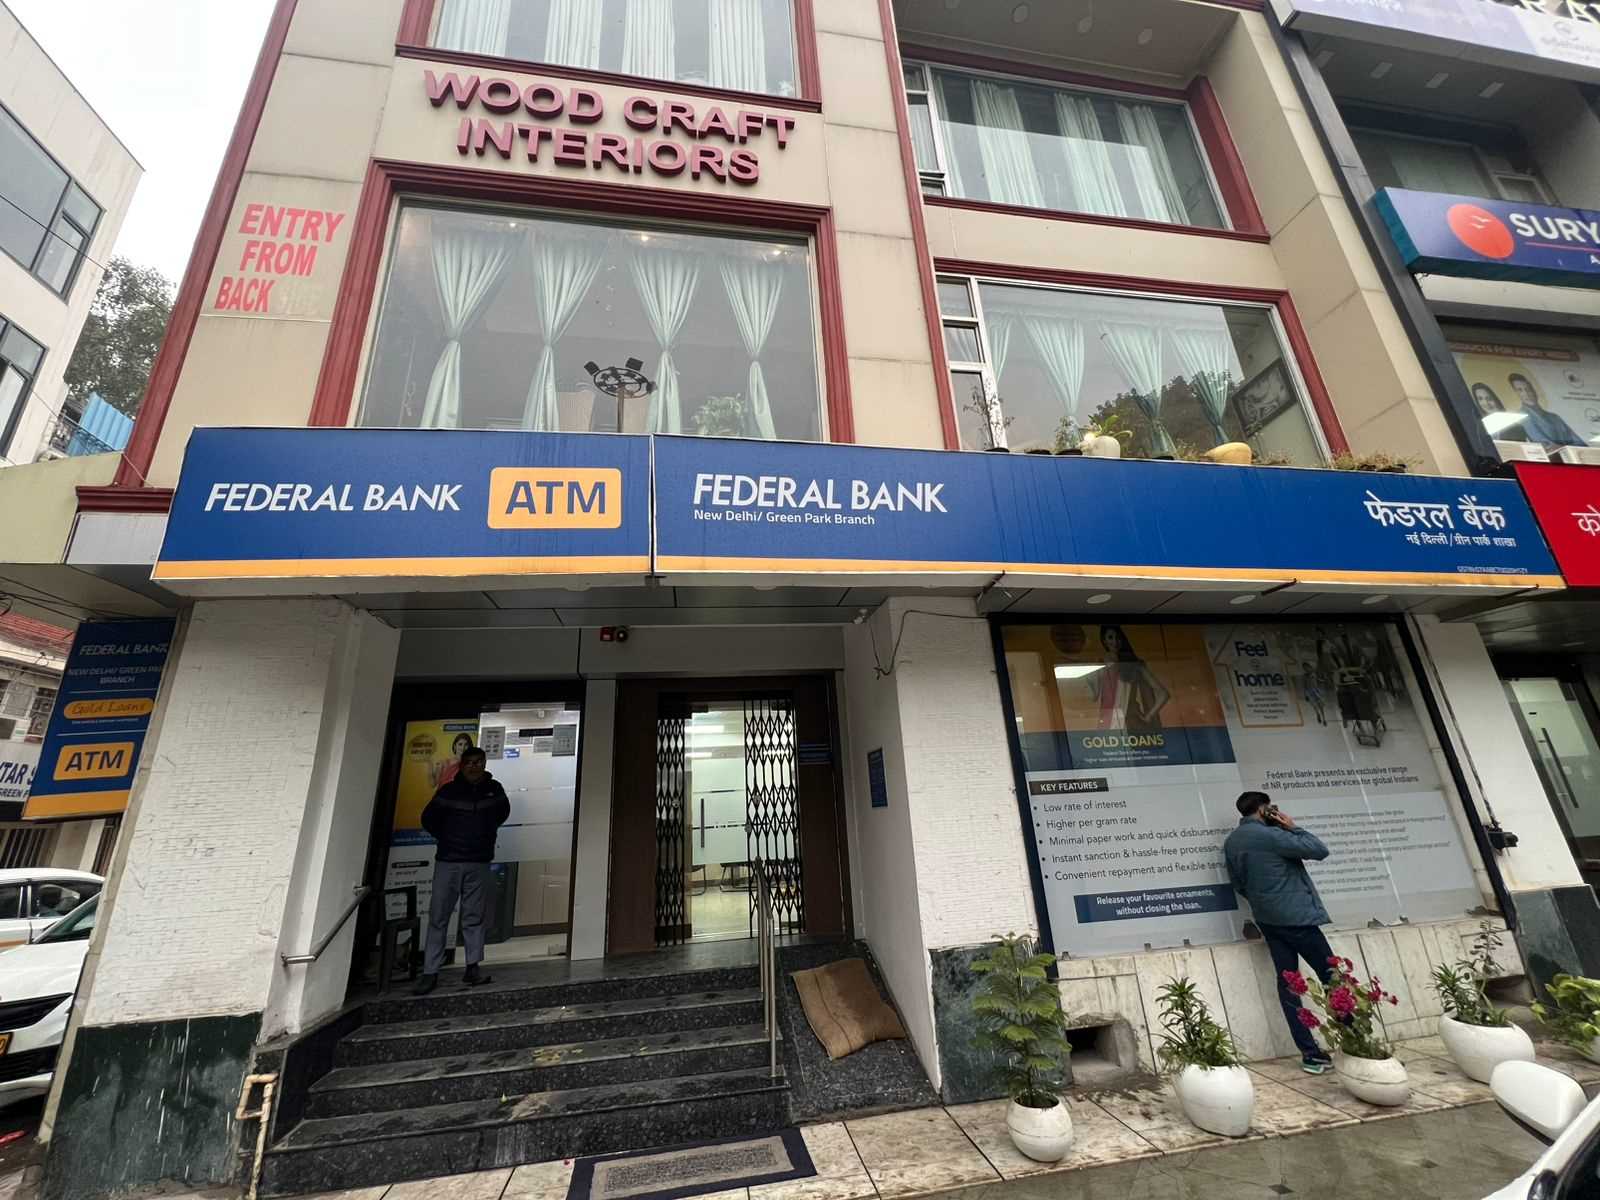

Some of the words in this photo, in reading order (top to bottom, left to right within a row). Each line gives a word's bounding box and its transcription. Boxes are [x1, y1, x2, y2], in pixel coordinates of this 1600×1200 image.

[424, 70, 603, 123] WOOD
[624, 96, 795, 148] CRAFT
[457, 117, 759, 184] INTERIORS
[239, 203, 345, 242] ENTRY
[240, 240, 318, 277] FROM
[214, 276, 275, 313] BACK
[204, 482, 354, 512] FEDERAL
[363, 483, 463, 512] BANK
[504, 480, 607, 515] ATM
[693, 473, 843, 509] FEDERAL
[850, 479, 948, 513] BANK
[694, 509, 722, 521] New
[766, 512, 802, 524] Green
[805, 513, 832, 524] Park
[834, 514, 875, 525] Branch
[1363, 490, 1454, 529] फेडरल
[1457, 494, 1506, 531] बैंक
[1405, 532, 1420, 546] नई
[1493, 536, 1517, 548] शाखा
[79, 643, 131, 656] FEDERAL
[1234, 640, 1269, 656] Feel
[1233, 669, 1285, 687] home
[71, 701, 103, 716] Gold
[107, 700, 146, 714] Loans
[1082, 736, 1119, 749] GOLD
[1122, 734, 1164, 747] LOANS
[64, 750, 125, 772] ATM
[1266, 770, 1294, 780] Federal
[1294, 769, 1312, 779] Bank
[1313, 768, 1346, 778] presents
[1355, 766, 1388, 775] exclusive
[1388, 765, 1408, 775] range
[1040, 783, 1056, 792] KEY
[1058, 781, 1098, 791] FEATURES
[1261, 781, 1269, 790] of
[1270, 781, 1281, 789] NR
[1282, 779, 1315, 791] products
[1316, 779, 1330, 788] and
[1330, 778, 1361, 787] services
[1372, 776, 1394, 787] global
[1395, 774, 1419, 784] Indians
[1043, 802, 1063, 813] Low
[1064, 802, 1082, 811] rate
[1083, 800, 1093, 811] of
[1094, 800, 1127, 809] interest
[1046, 819, 1077, 831] Higher
[1078, 820, 1093, 830] per
[1096, 819, 1118, 829] gram
[1119, 816, 1137, 825] rate
[1049, 834, 1084, 847] Minimal
[1086, 834, 1112, 846] paper
[1114, 830, 1135, 841] work
[1137, 829, 1154, 840] and
[1155, 829, 1178, 840] quick
[1052, 853, 1082, 864] Instant
[1084, 851, 1121, 861] sanction
[1123, 849, 1130, 858] &
[1132, 845, 1178, 857] hassle-free
[1054, 868, 1106, 881] Convenient
[1108, 867, 1155, 878] repayment
[1157, 863, 1173, 873] and
[1175, 860, 1205, 870] flexible
[1096, 895, 1124, 905] Release
[1125, 895, 1142, 905] your
[1143, 891, 1175, 902] favourite
[1116, 905, 1144, 916] without
[1145, 903, 1171, 915] closing
[1171, 902, 1183, 912] the
